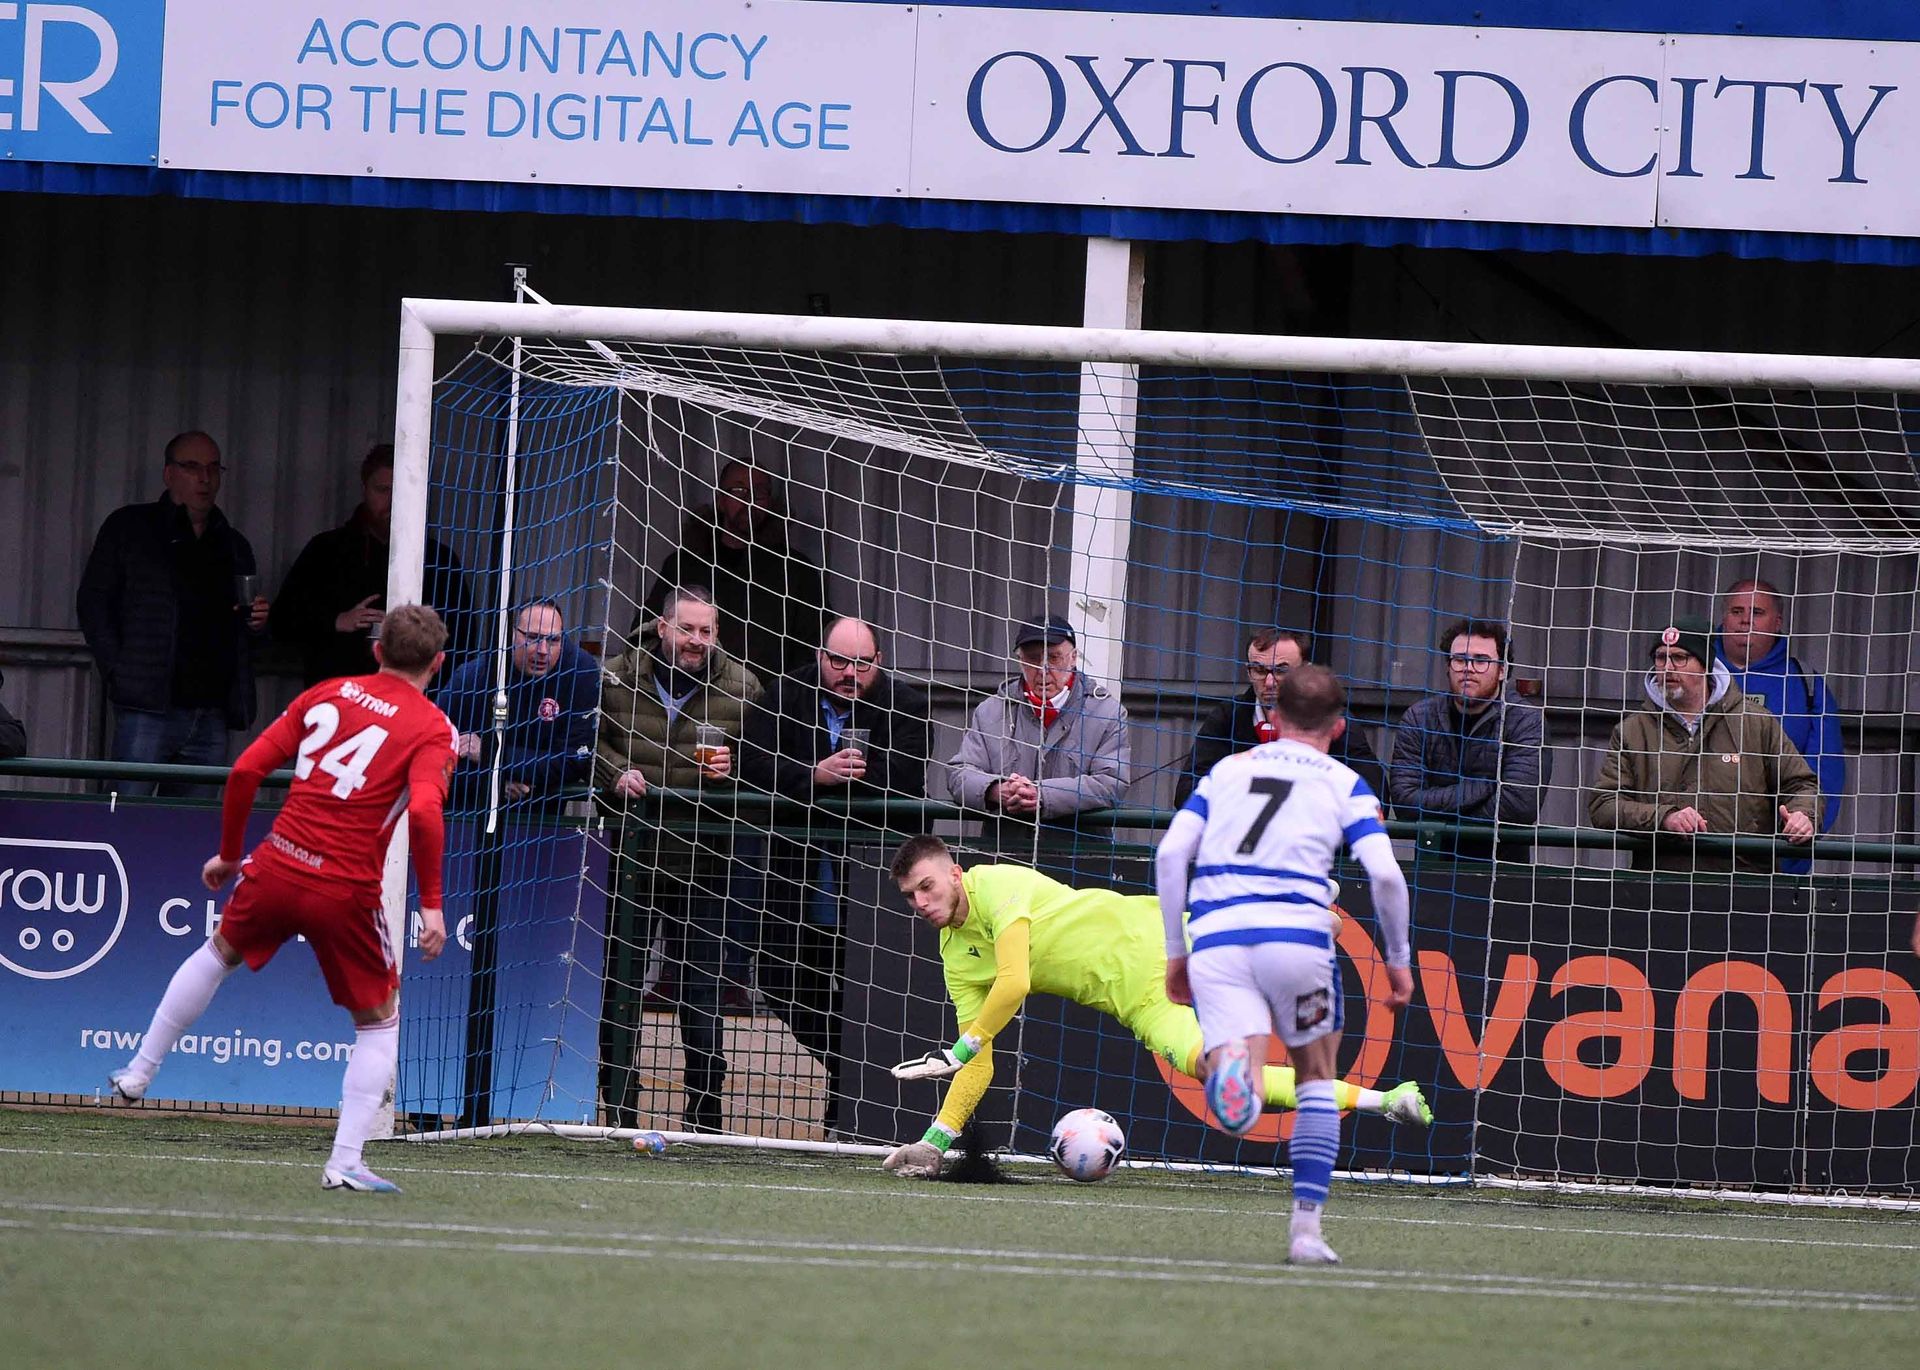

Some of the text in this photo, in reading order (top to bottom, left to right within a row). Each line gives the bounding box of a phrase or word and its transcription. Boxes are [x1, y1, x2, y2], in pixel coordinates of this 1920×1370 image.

[297, 17, 768, 82] ACCOUNTANCY
[210, 80, 851, 151] FOR THE DIGITAL AGE
[966, 50, 1899, 185] OXFORD CITY
[295, 702, 389, 801] 24
[1235, 776, 1294, 855] 7
[0, 868, 106, 914] raw
